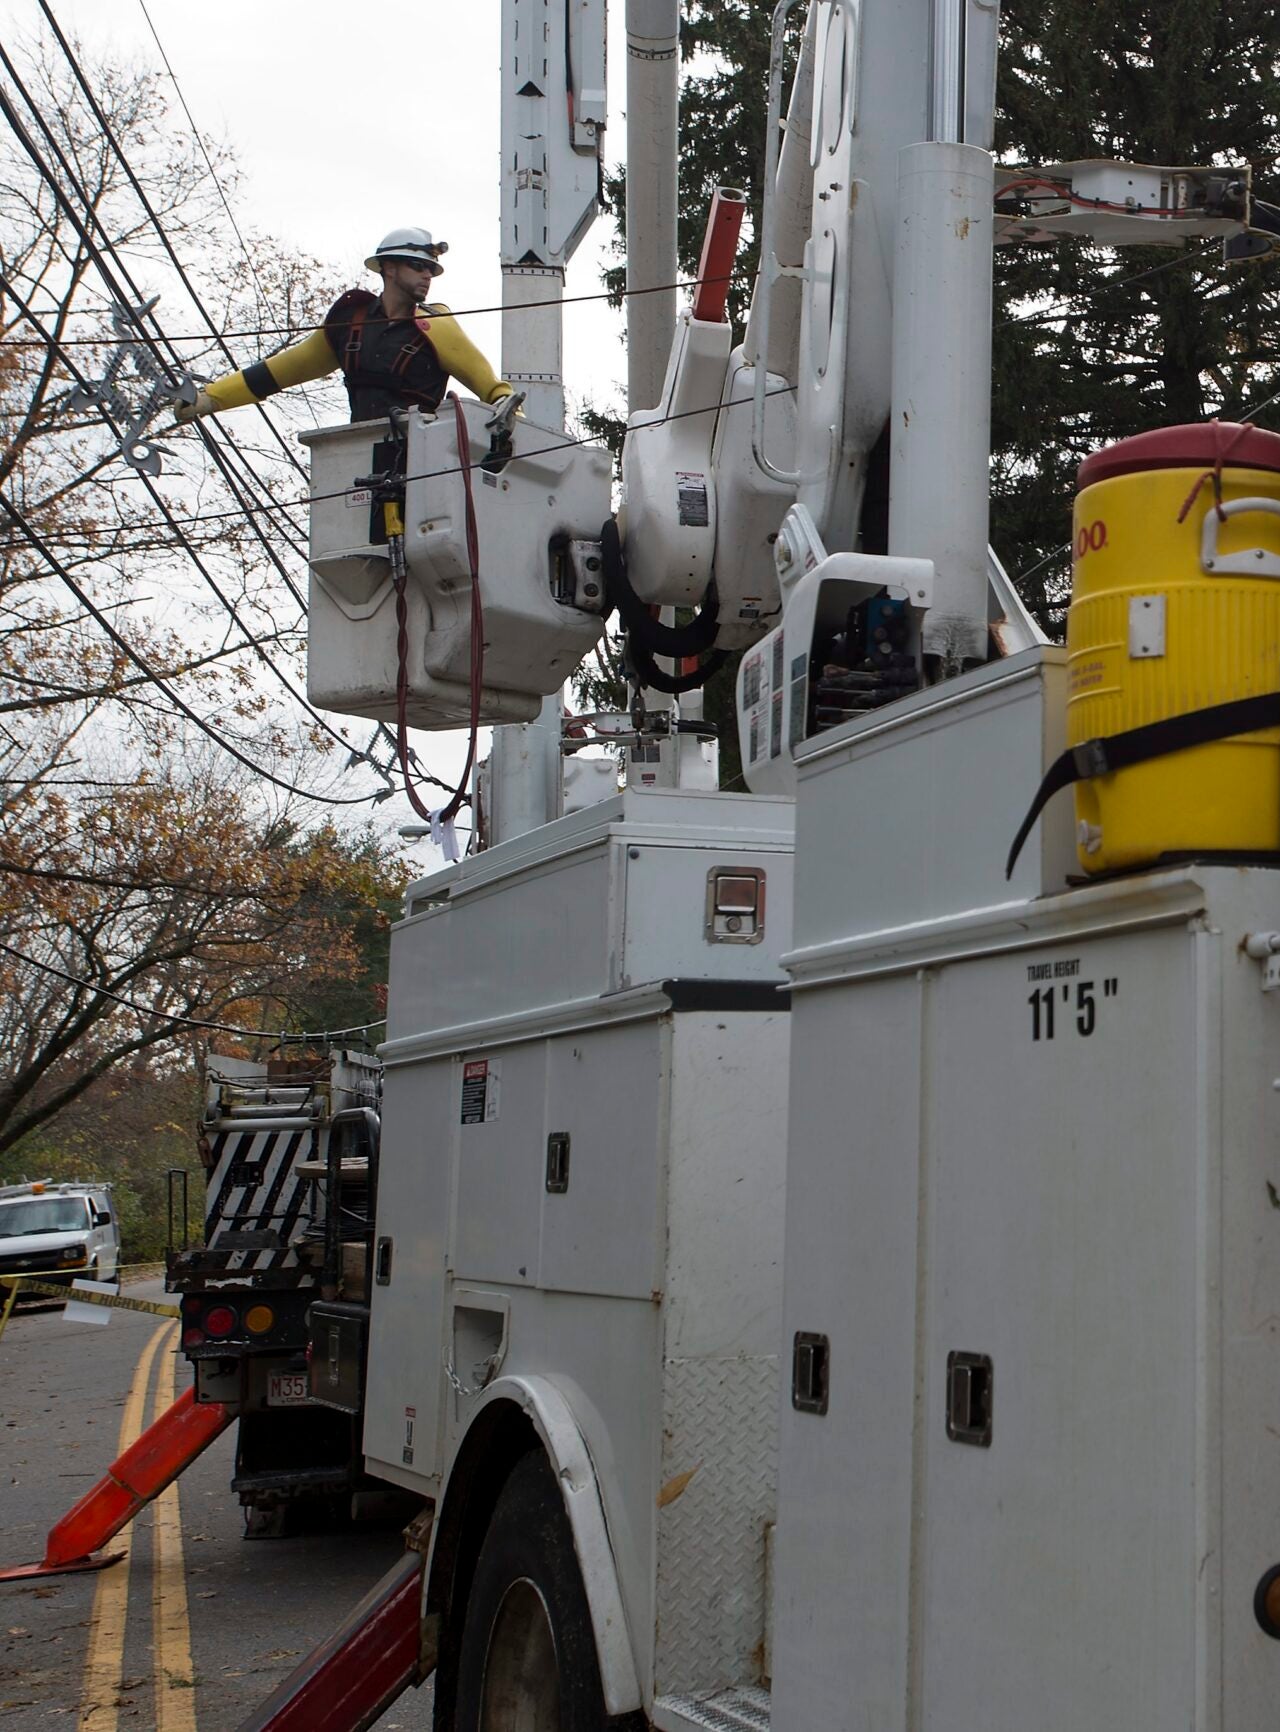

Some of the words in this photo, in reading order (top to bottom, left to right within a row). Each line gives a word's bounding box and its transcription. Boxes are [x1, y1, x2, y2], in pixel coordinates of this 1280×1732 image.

[1027, 964, 1052, 982] TRAVEL
[1054, 959, 1081, 978] HEIGHT
[29, 1280, 92, 1302] NEEDHAM
[101, 1294, 162, 1314] HIGHWAY
